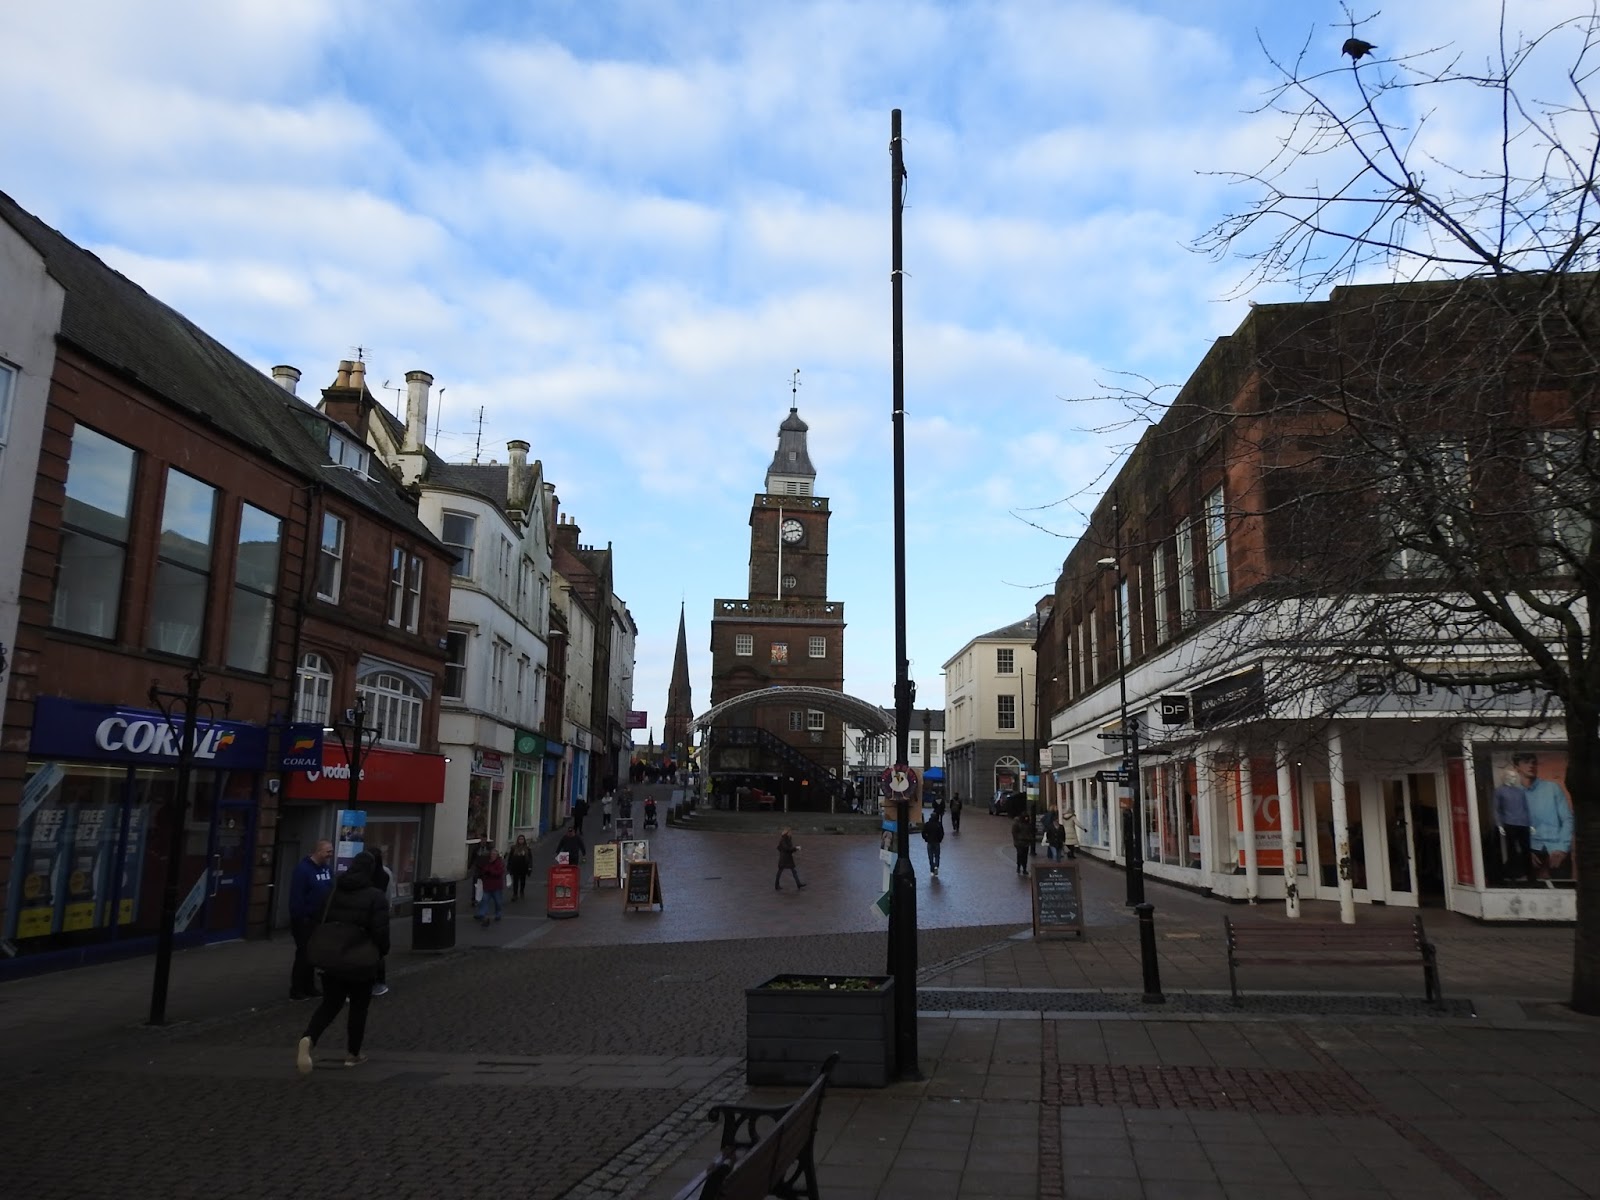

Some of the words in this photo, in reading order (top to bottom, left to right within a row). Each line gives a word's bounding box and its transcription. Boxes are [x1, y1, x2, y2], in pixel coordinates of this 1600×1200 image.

[283, 758, 317, 766] CORAL
[322, 763, 365, 780] vodafe
[35, 809, 66, 824] FREE
[79, 809, 106, 823] FREE
[32, 825, 61, 841] BET
